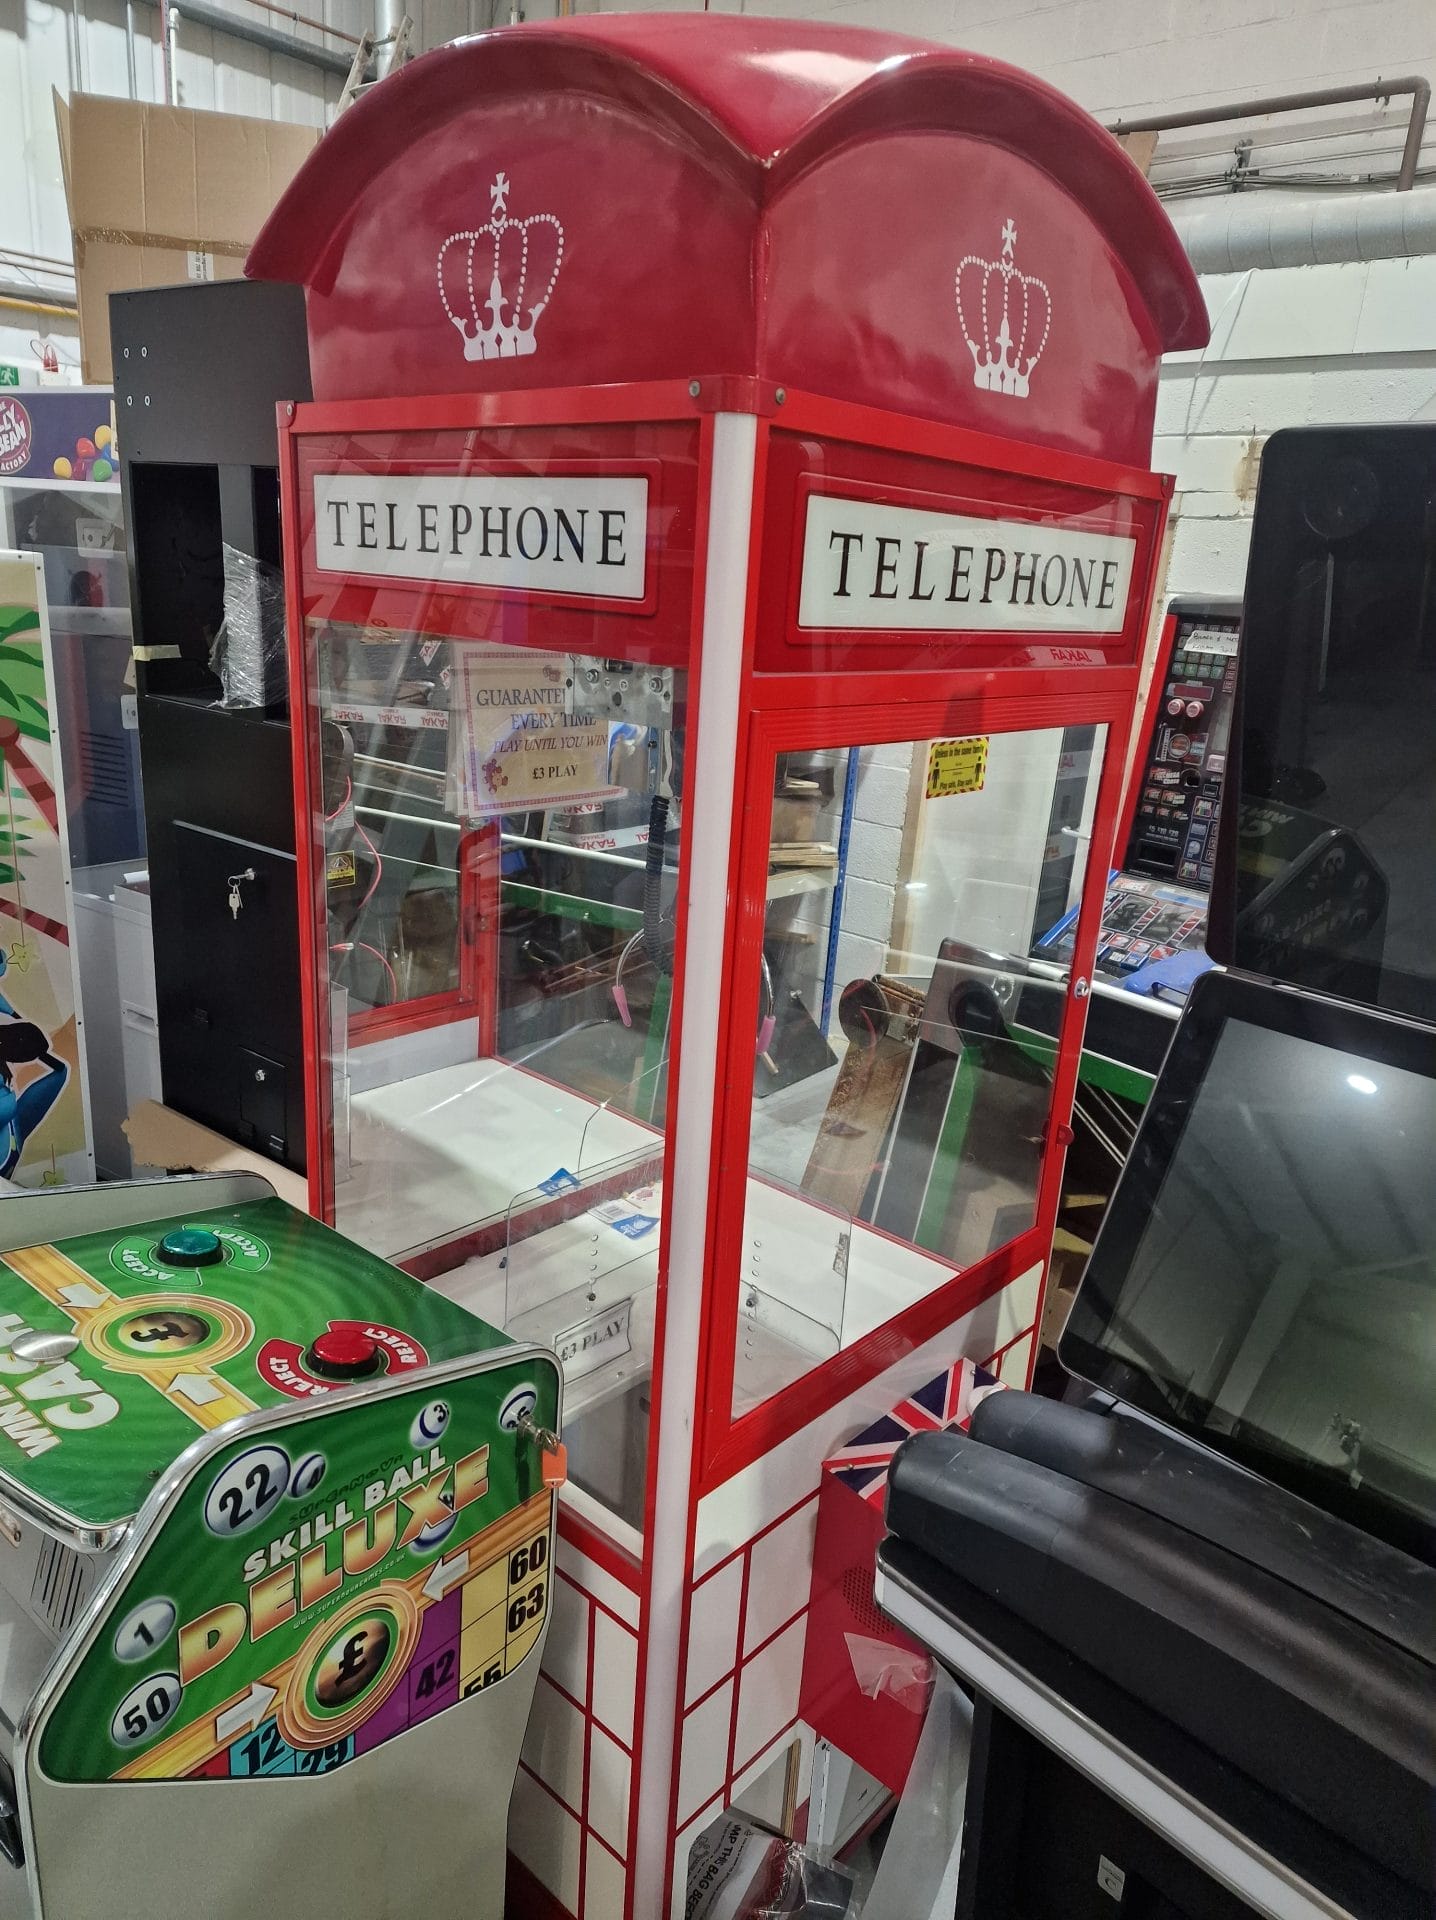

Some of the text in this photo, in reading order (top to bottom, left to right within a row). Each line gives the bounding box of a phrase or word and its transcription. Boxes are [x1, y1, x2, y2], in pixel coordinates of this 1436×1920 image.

[326, 500, 627, 566] TELEPHONE
[829, 530, 1119, 609] TELEPHONE
[494, 734, 608, 753] PLAY UNTIL YOU WIN
[511, 713, 597, 730] EVERY TIME
[532, 764, 578, 780] £3 PLAY
[122, 1248, 176, 1281] ACCEPT
[211, 1229, 261, 1258] ACCEPT
[361, 1327, 418, 1364] REJECT
[560, 1317, 625, 1363] £3 PLAY
[269, 1357, 330, 1396] REJECT
[218, 1463, 279, 1530] 22
[243, 1446, 446, 1583] SKILL BALL
[178, 1443, 490, 1689] DELUXE
[511, 1535, 547, 1585] 60
[508, 1582, 545, 1633] 63
[133, 1622, 155, 1647] 1
[415, 1649, 456, 1700] 42
[122, 1686, 171, 1739] 50
[241, 1723, 286, 1776] 12
[699, 1864, 719, 1889] BAG
